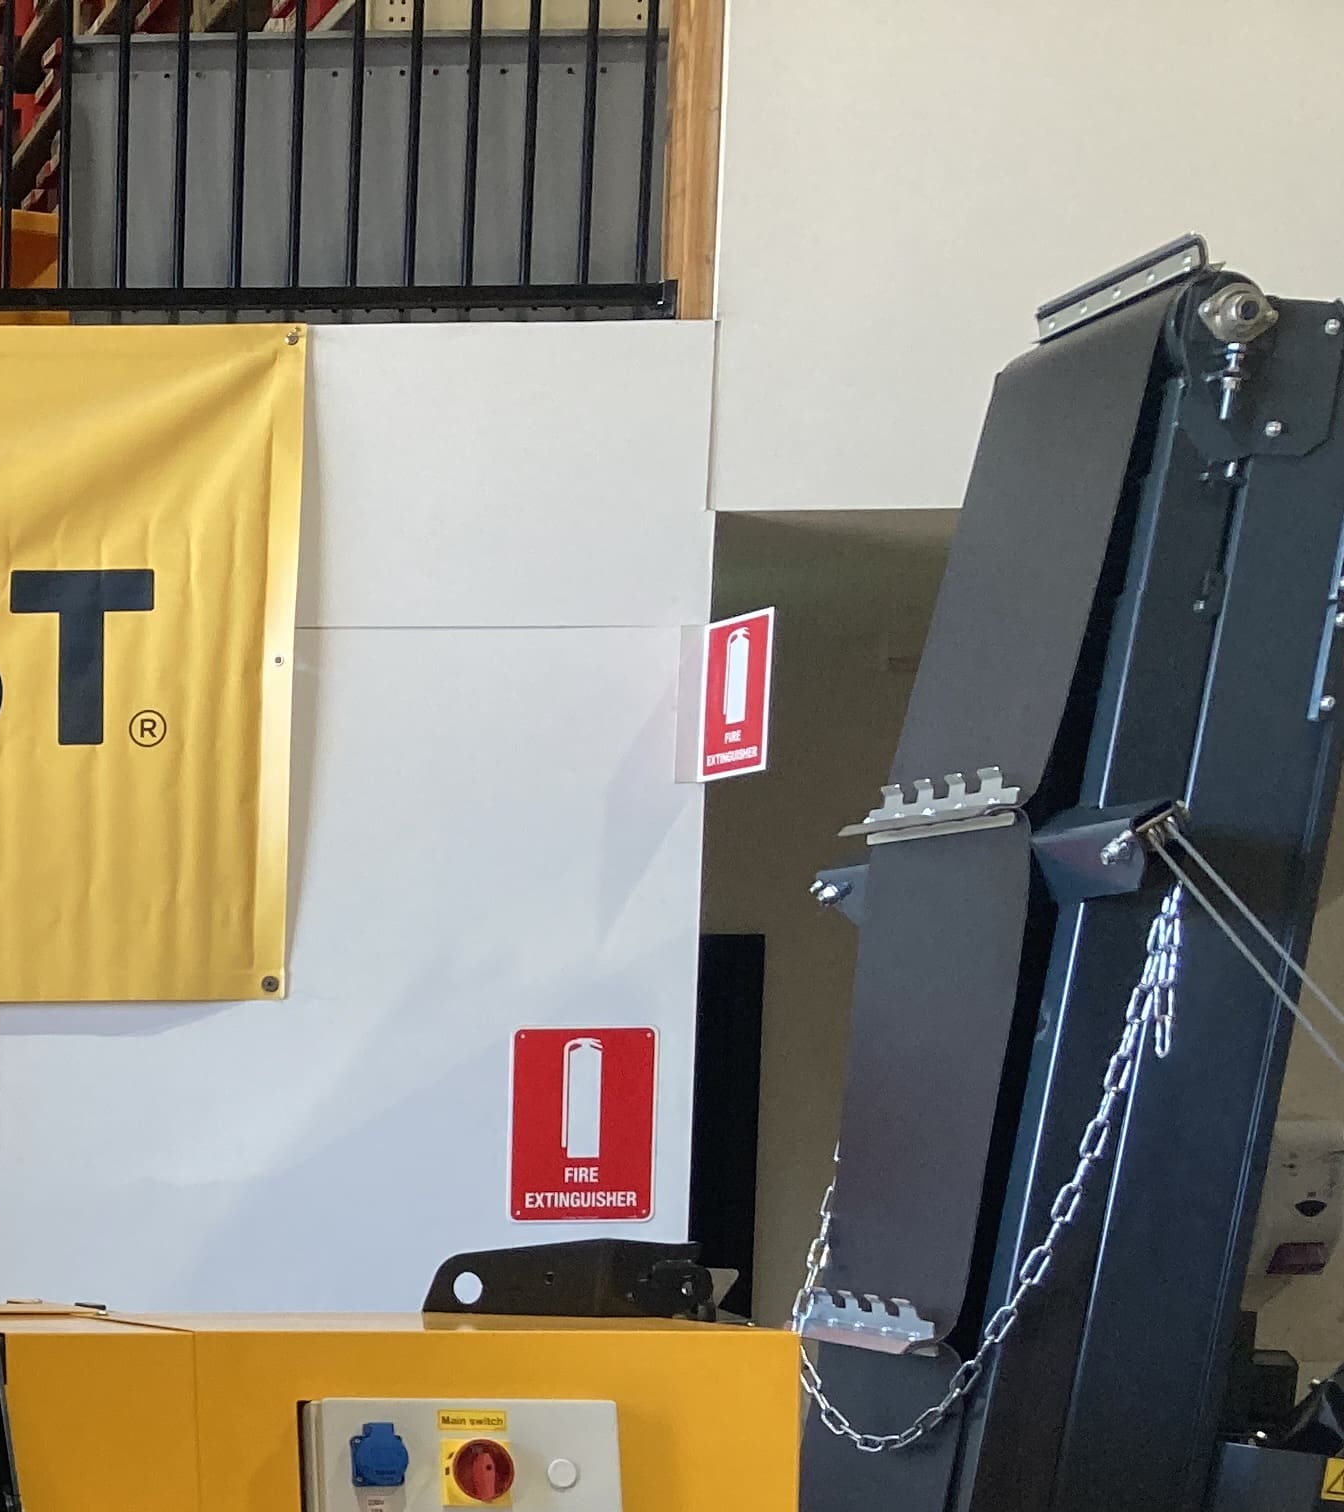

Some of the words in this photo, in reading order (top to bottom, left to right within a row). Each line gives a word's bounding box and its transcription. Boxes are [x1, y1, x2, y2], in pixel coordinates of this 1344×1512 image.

[724, 729, 742, 745] FIRE
[564, 1167, 599, 1183] FIRE
[525, 1191, 638, 1208] EXTINGUISHER
[441, 1416, 466, 1425] Main
[469, 1416, 504, 1426] switch
